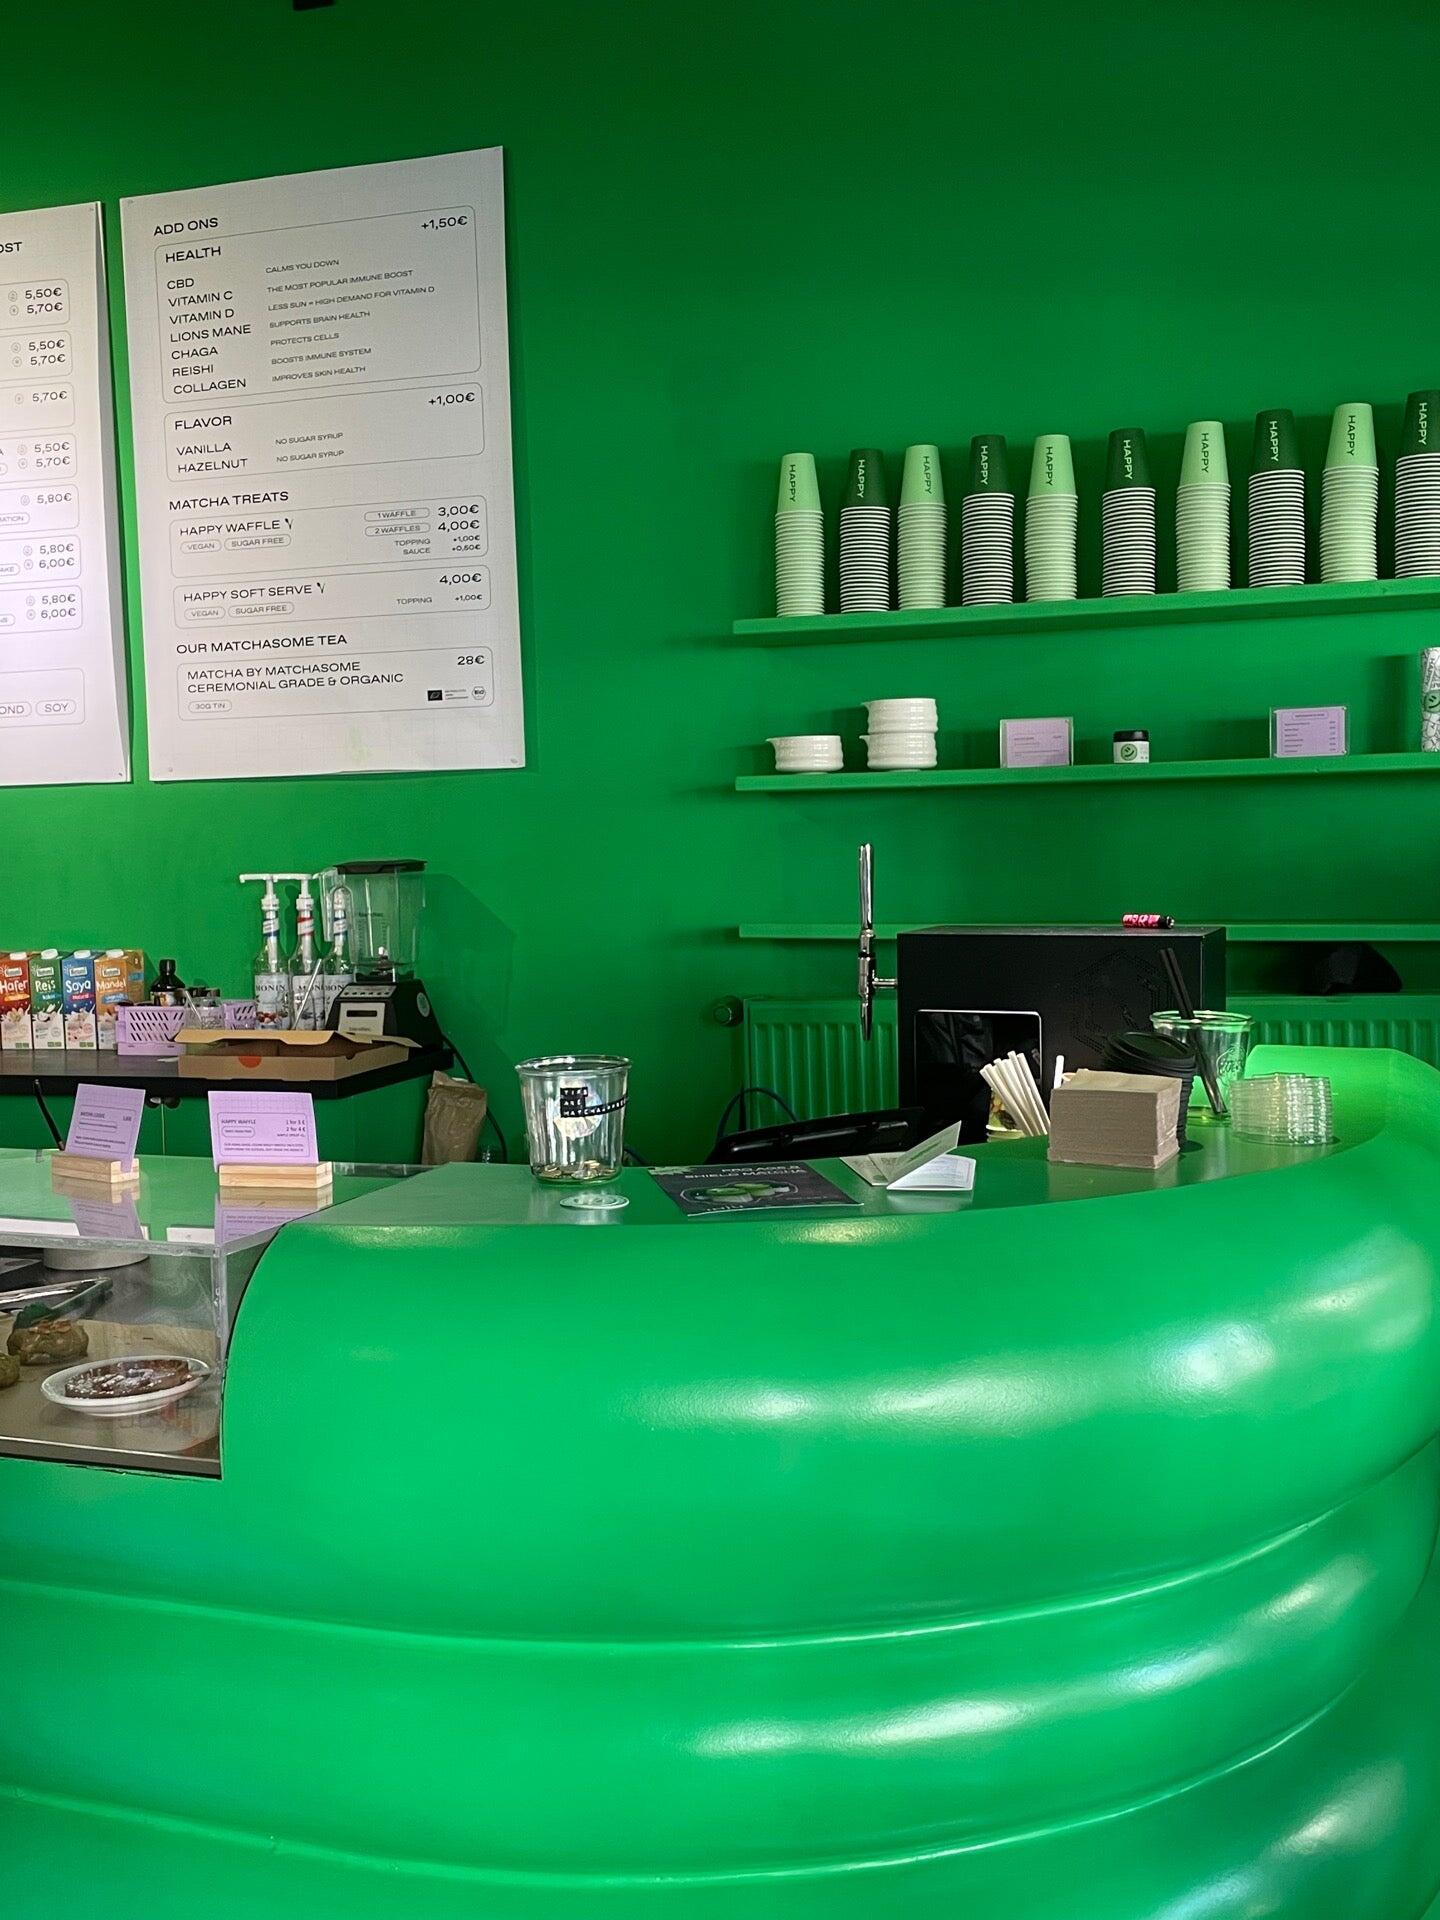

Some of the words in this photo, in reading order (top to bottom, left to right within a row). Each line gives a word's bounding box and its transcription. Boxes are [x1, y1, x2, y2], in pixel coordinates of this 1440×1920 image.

[154, 222, 183, 236] ADD
[188, 218, 218, 231] ONS
[421, 216, 468, 232] +1,50€
[166, 246, 221, 263] HEALTH
[266, 264, 294, 274] CALMS
[296, 262, 312, 270] YOU
[314, 260, 339, 268] DOWN
[167, 278, 195, 290] CBD
[267, 285, 283, 293] THE
[285, 283, 308, 291] MOST
[310, 278, 348, 288] POPULAR
[350, 274, 383, 283] IMMUNE
[384, 270, 413, 280] BOOST
[25, 288, 62, 300] 5,50€
[168, 292, 220, 307] VITAMIN
[224, 291, 233, 300] C
[268, 302, 288, 311] LESS
[290, 300, 307, 309] SUN
[315, 298, 336, 306] HIGH
[337, 293, 372, 303] DEMAND
[374, 291, 391, 299] FOR
[393, 288, 426, 297] VITAMIN
[27, 302, 63, 314] 5,70€
[170, 310, 221, 324] VITAMIN
[225, 308, 234, 318] D
[270, 318, 311, 328] SUPPORTS
[314, 315, 337, 324] BRAIN
[338, 311, 370, 320] HEALTH
[171, 330, 209, 342] LIONS
[213, 324, 251, 337] MANE
[270, 336, 312, 346] PROTECTS
[314, 333, 339, 342] CELLS
[28, 339, 65, 351] 5,50€
[30, 354, 66, 366] 5,70€
[172, 347, 218, 360] CHAGA
[272, 355, 303, 365] BOOSTS
[306, 352, 337, 361] IMMUNE
[338, 348, 372, 357] SYSTEM
[172, 364, 214, 377] REISHI
[272, 372, 313, 382] IMPROVES
[315, 370, 333, 378] SKIN
[334, 366, 366, 375] HEALTH
[174, 378, 247, 394] COLLAGEN
[32, 391, 67, 402] 5,70€
[428, 392, 475, 408] +1,00€
[175, 416, 232, 430] FLAVOR
[1419, 403, 1427, 445] HAPPY
[289, 436, 316, 444] SUGAR
[318, 432, 344, 441] SYRUP
[1269, 421, 1279, 461] HAPPY
[1348, 415, 1356, 456] HAPPY
[35, 442, 70, 453] 5,50€
[176, 442, 232, 456] VANILLA
[1201, 433, 1209, 473] HAPPY
[36, 457, 71, 468] 5,70€
[290, 453, 317, 461] SUGAR
[318, 450, 345, 458] SYRUP
[1124, 440, 1133, 479] HAPPY
[178, 458, 248, 473] HAZELNUT
[980, 446, 988, 485] HAPPY
[857, 460, 865, 498] HAPPY
[924, 456, 932, 495] HAPPY
[37, 493, 72, 504] 5,80€
[170, 497, 230, 510] MATCHA
[232, 492, 289, 505] TREATS
[382, 510, 416, 518] WAFFLE
[438, 505, 479, 517] 3,00€
[180, 525, 222, 536] HAPPY
[226, 520, 280, 532] WAFFLE
[381, 526, 420, 534] WAFFLES
[438, 520, 480, 532] 4,00€
[39, 543, 74, 555] 5,80€
[232, 539, 261, 547] SUGAR
[394, 538, 431, 546] TOPPING
[39, 557, 75, 569] 6,00€
[440, 573, 482, 585] 4,00€
[41, 594, 76, 605] 5,80€
[184, 591, 227, 602] HAPPY
[231, 588, 265, 599] SOFT
[268, 585, 312, 597] SERVE
[41, 608, 77, 619] 6,00€
[236, 606, 264, 614] SUGAR
[176, 644, 207, 654] OUR
[211, 636, 315, 652] MATCHASOME
[318, 634, 347, 645] TEA
[458, 655, 485, 665] 28€
[188, 668, 243, 680] MATCHA
[246, 667, 262, 677] BY
[266, 662, 361, 676] MATCHASOME
[188, 681, 276, 693] CEREMONIAL
[279, 678, 325, 688] GRADE
[328, 677, 337, 686] &
[340, 673, 404, 685] ORGANIC
[44, 703, 69, 712] SOY
[0, 980, 28, 994] Hafer
[35, 980, 56, 992] Reis
[65, 980, 91, 993] Soya
